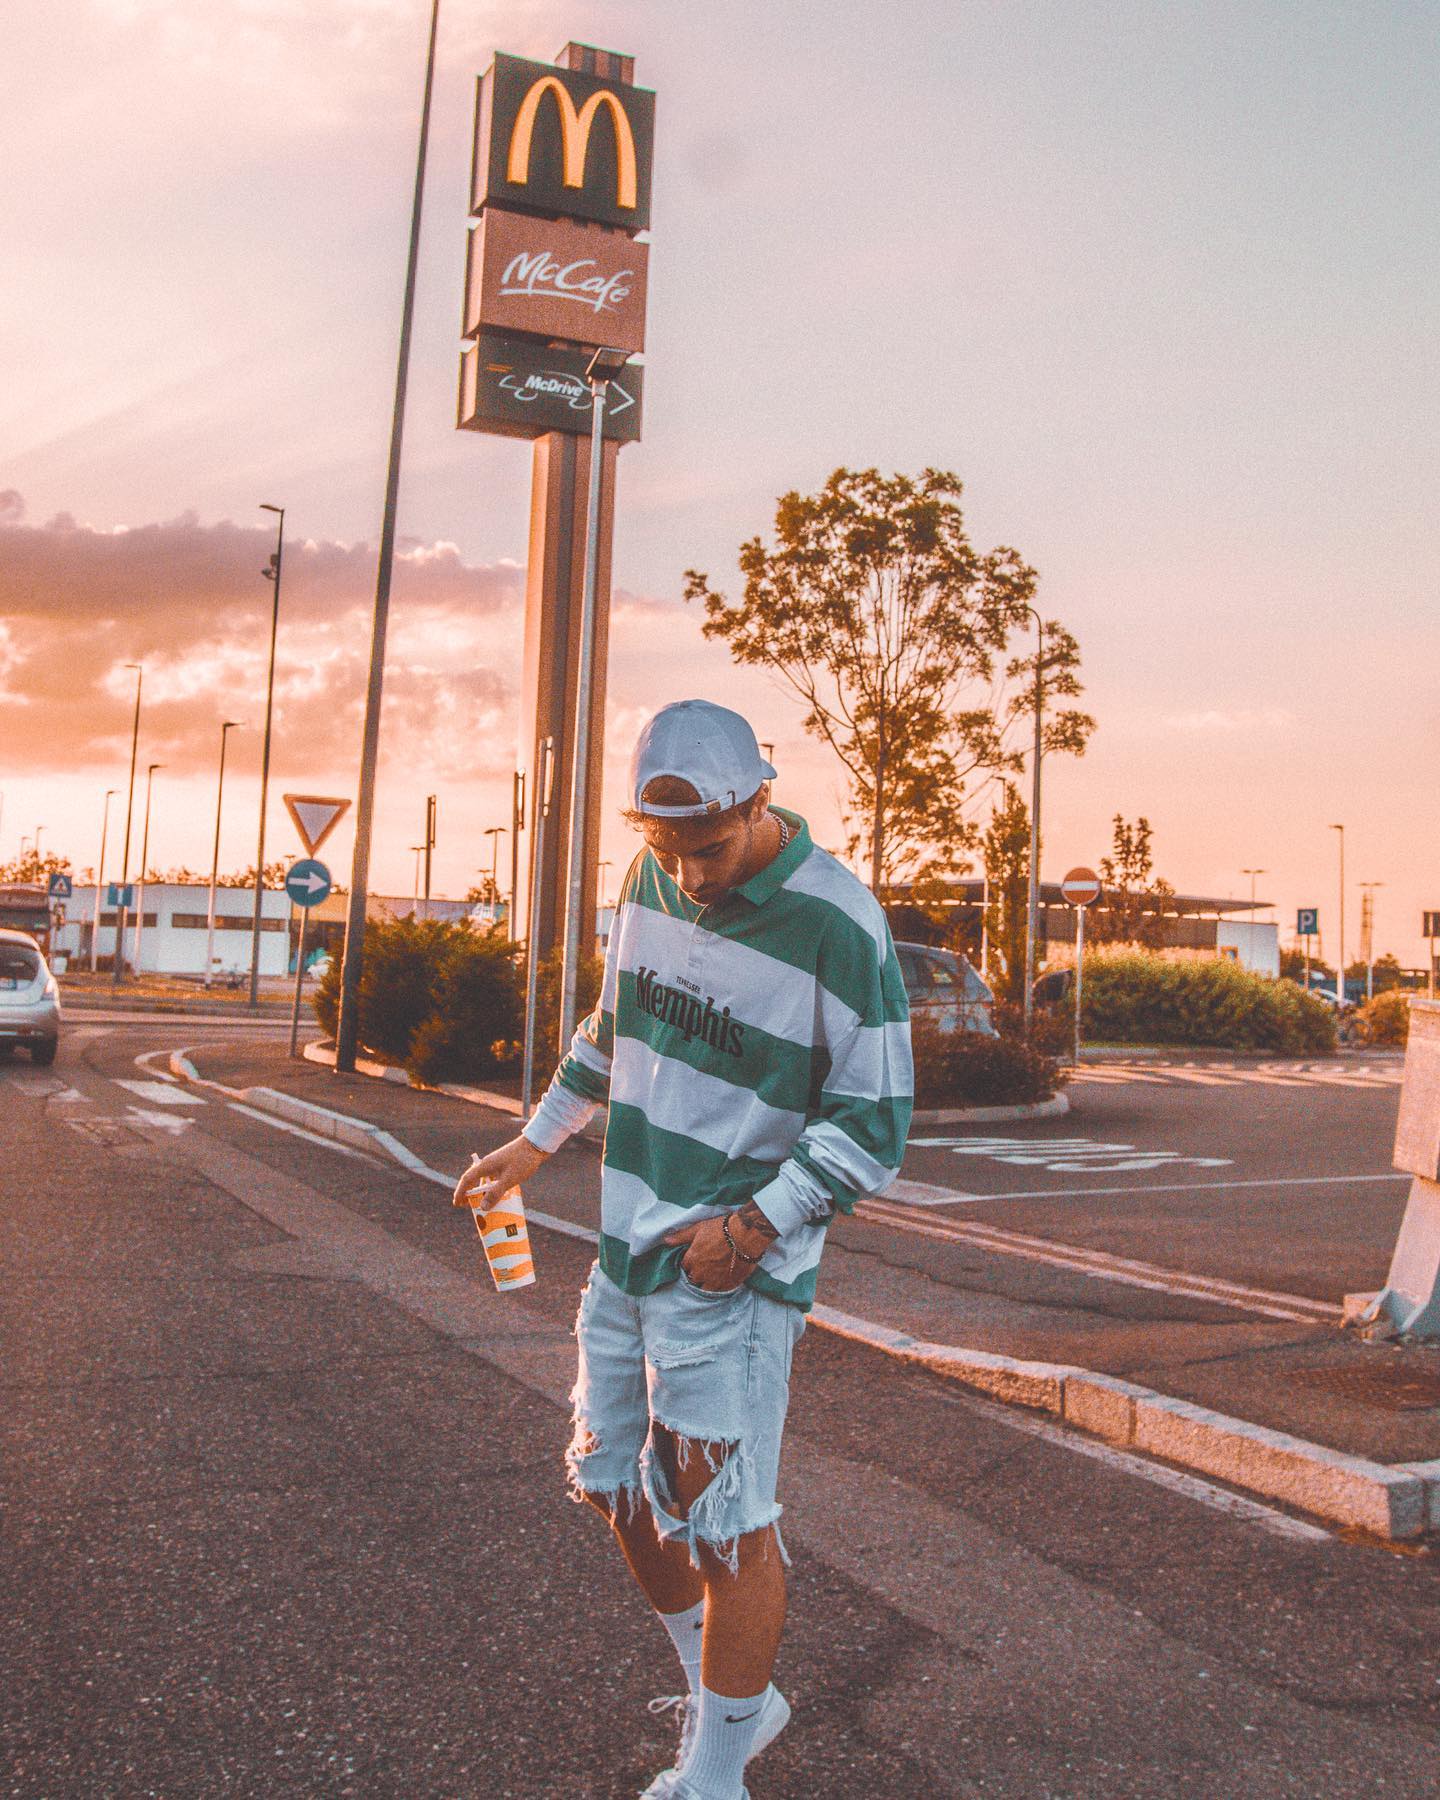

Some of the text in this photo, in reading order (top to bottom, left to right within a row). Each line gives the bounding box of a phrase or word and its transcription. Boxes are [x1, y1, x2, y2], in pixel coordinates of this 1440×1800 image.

[506, 76, 637, 209] M
[525, 375, 584, 397] McDrive
[1300, 911, 1314, 932] P
[676, 975, 701, 994] TENNESSEE
[637, 966, 745, 1058] Memphis
